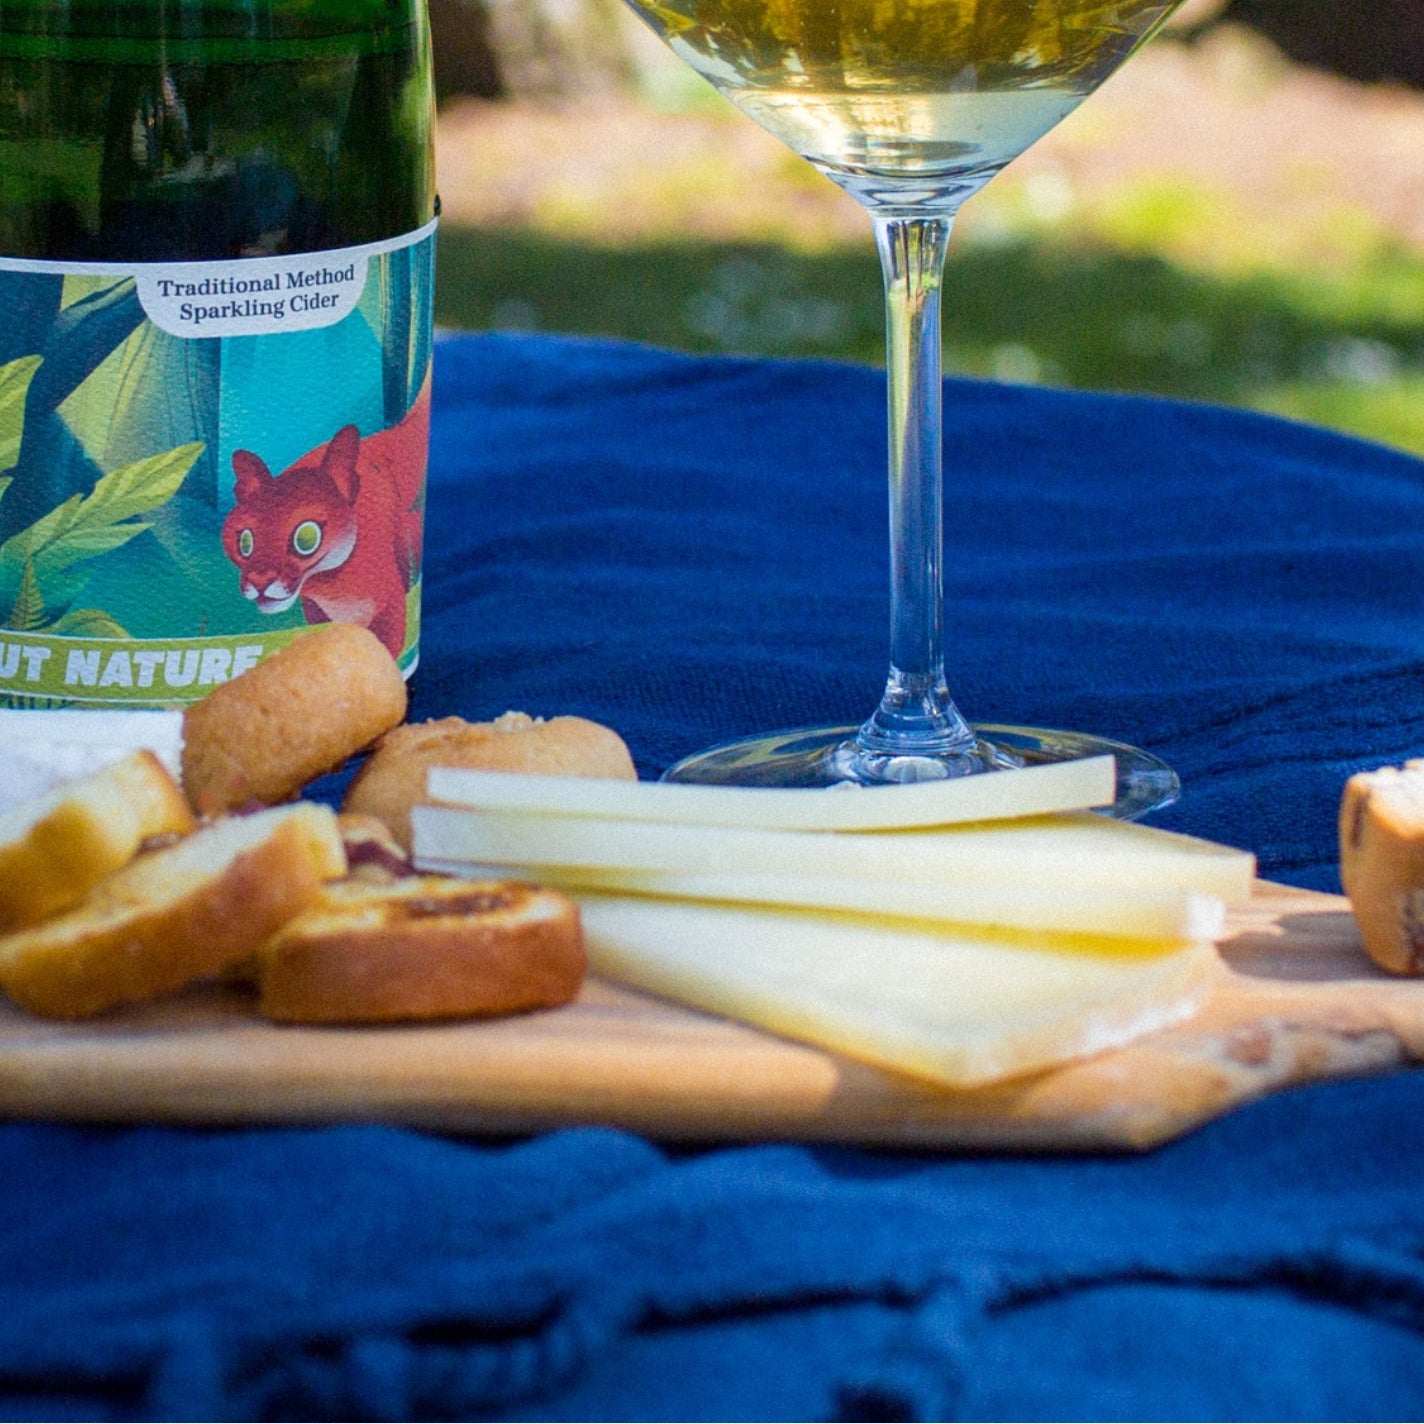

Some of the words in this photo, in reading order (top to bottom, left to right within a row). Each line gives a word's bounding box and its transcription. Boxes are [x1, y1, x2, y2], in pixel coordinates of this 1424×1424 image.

[158, 273, 280, 297] Traditional
[286, 264, 355, 289] Method
[179, 299, 284, 324] Sparkling
[290, 293, 339, 313] Cider
